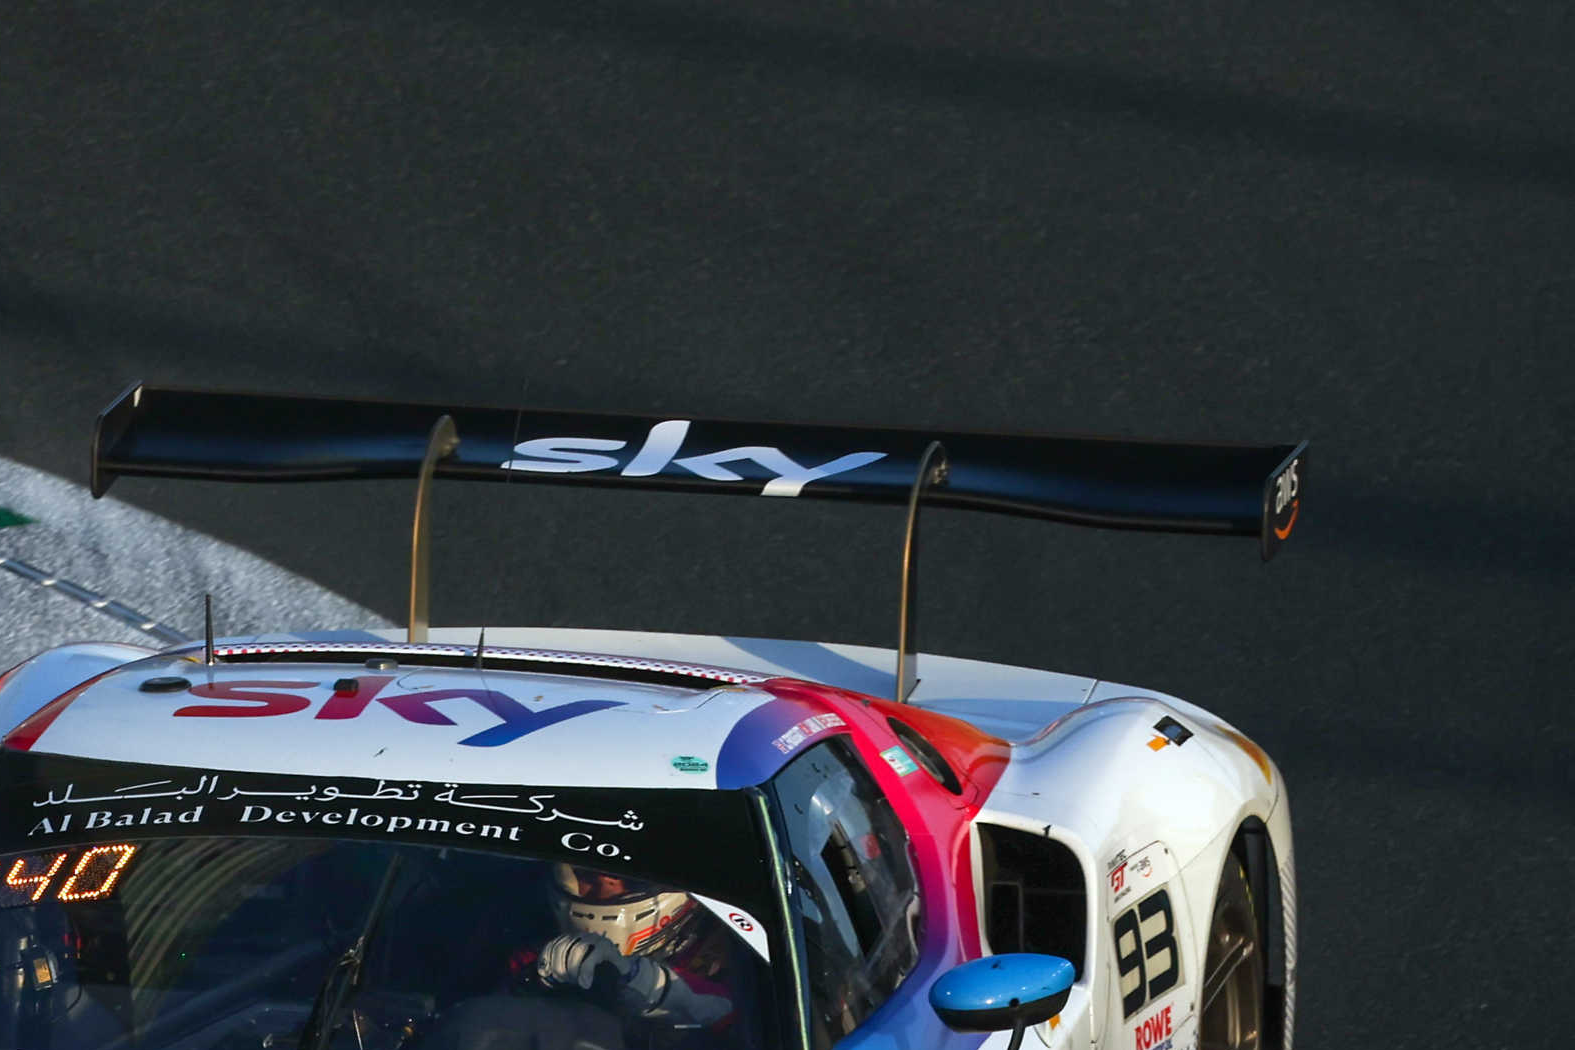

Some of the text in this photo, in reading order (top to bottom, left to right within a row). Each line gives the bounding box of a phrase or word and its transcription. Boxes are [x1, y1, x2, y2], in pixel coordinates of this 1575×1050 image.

[500, 420, 888, 497] sky
[173, 676, 629, 747] sky
[28, 804, 633, 862] Al Balad Development Co.
[33, 775, 645, 833] شركة تطوير البلد
[1114, 889, 1180, 1020] 93
